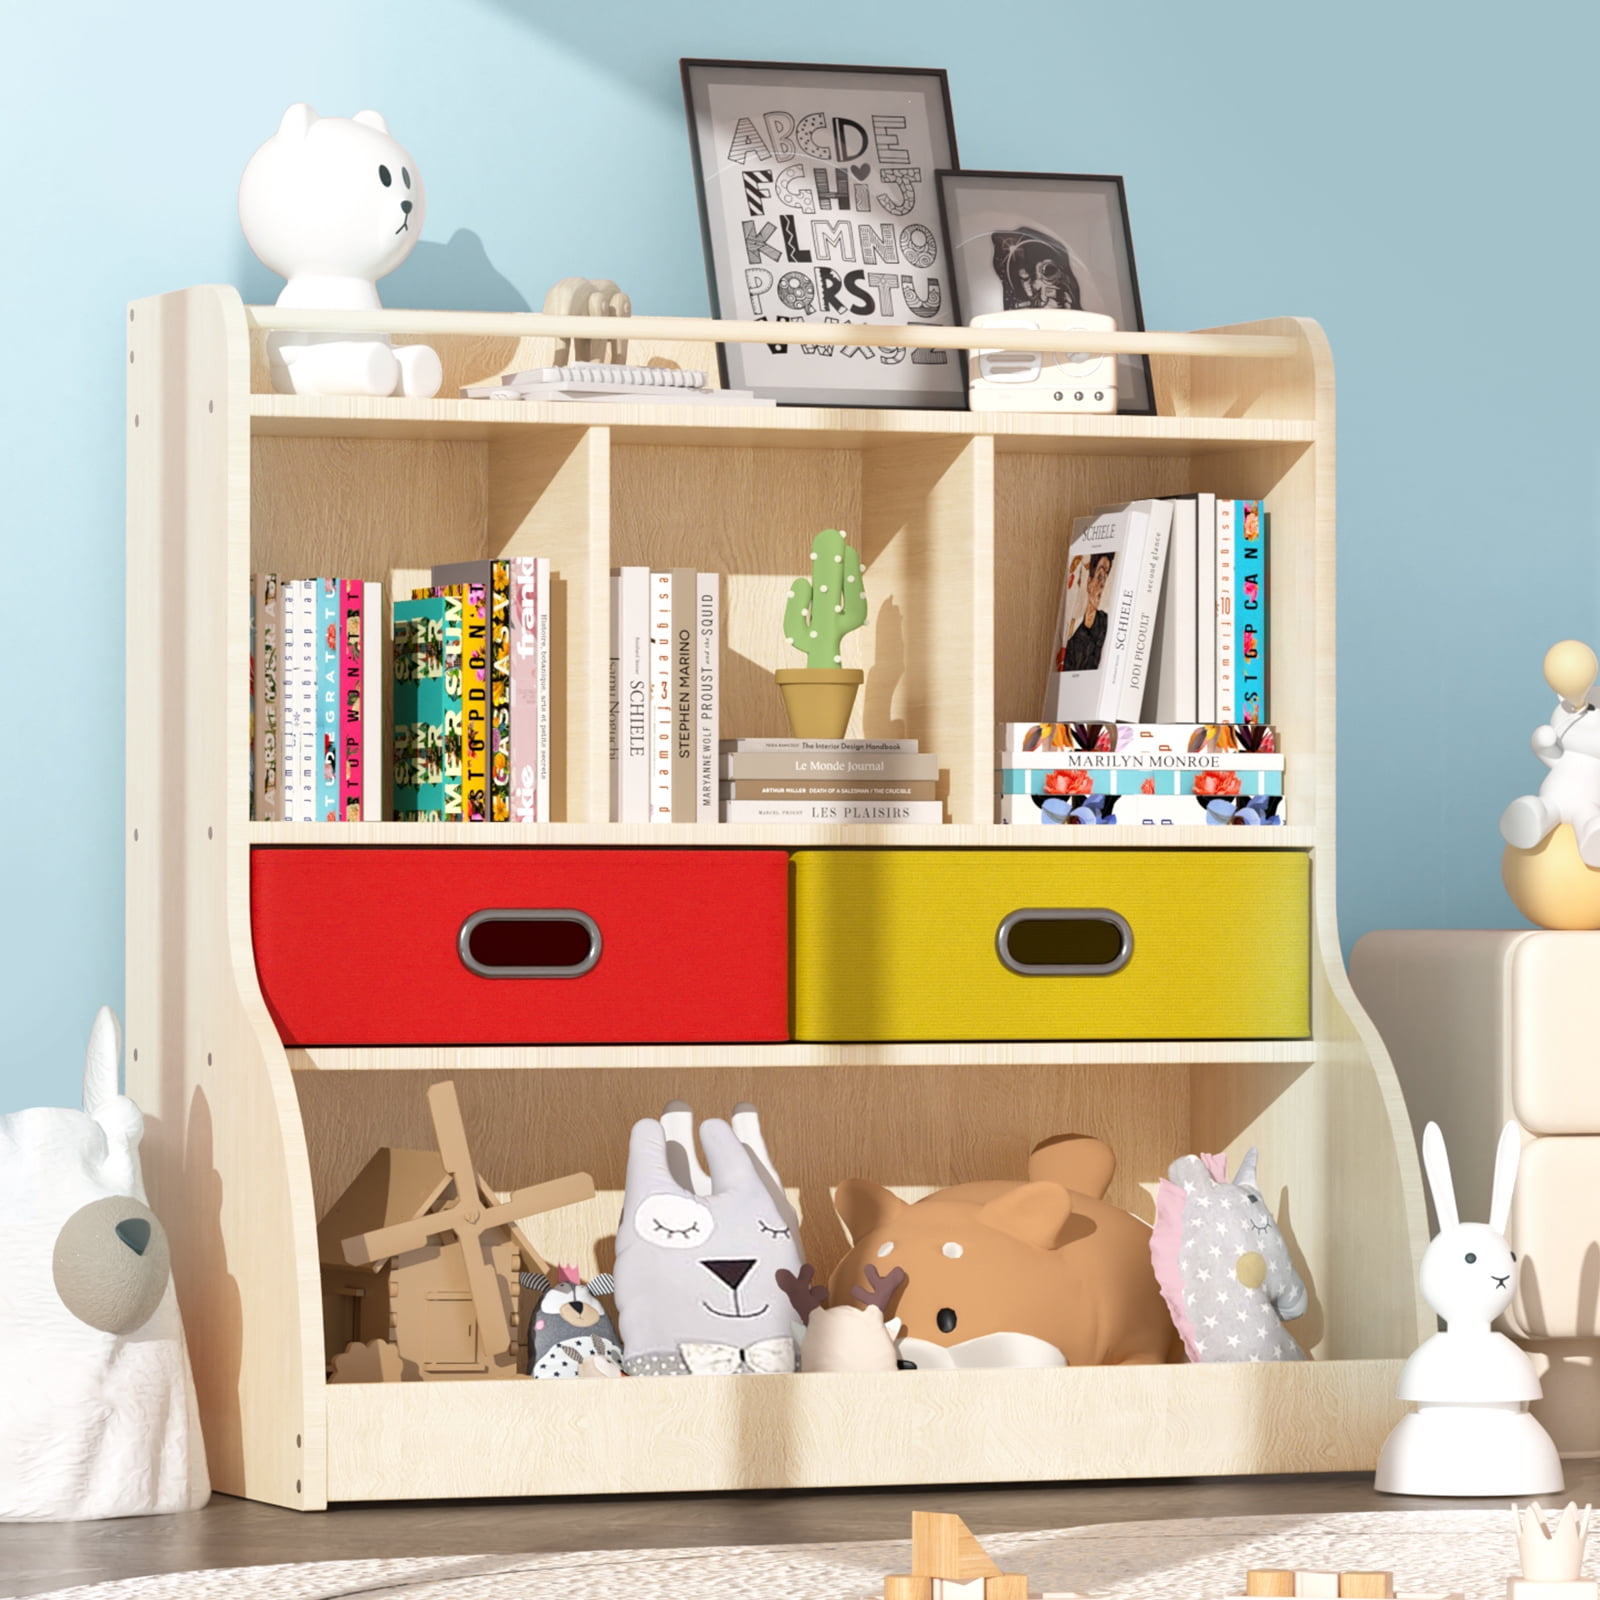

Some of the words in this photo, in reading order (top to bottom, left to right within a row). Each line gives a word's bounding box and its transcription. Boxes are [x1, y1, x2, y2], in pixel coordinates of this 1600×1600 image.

[742, 214, 937, 269] KLMNO
[744, 266, 942, 318] PQRSTU
[701, 594, 713, 636] SQUID
[1115, 589, 1133, 651] SCHIELE
[1134, 612, 1150, 661] PICOULT
[679, 629, 690, 688] MARINO
[1130, 663, 1142, 689] JODI
[630, 680, 644, 756] SCHIELE
[701, 667, 713, 719] PROUST
[679, 692, 690, 758] STEPHEN
[702, 727, 711, 752] WOLF
[802, 742, 814, 750] The
[815, 742, 840, 750] Interior
[841, 742, 864, 751] Design
[865, 742, 900, 750] Handbook
[702, 753, 711, 806] MARYANNE
[795, 761, 807, 771] Le
[810, 760, 845, 771] Monde
[847, 761, 885, 773] Journal
[1068, 755, 1144, 768] MARILYN
[1149, 755, 1220, 768] MONROE
[812, 807, 838, 818] LES
[844, 807, 910, 818] PLAISIRS
